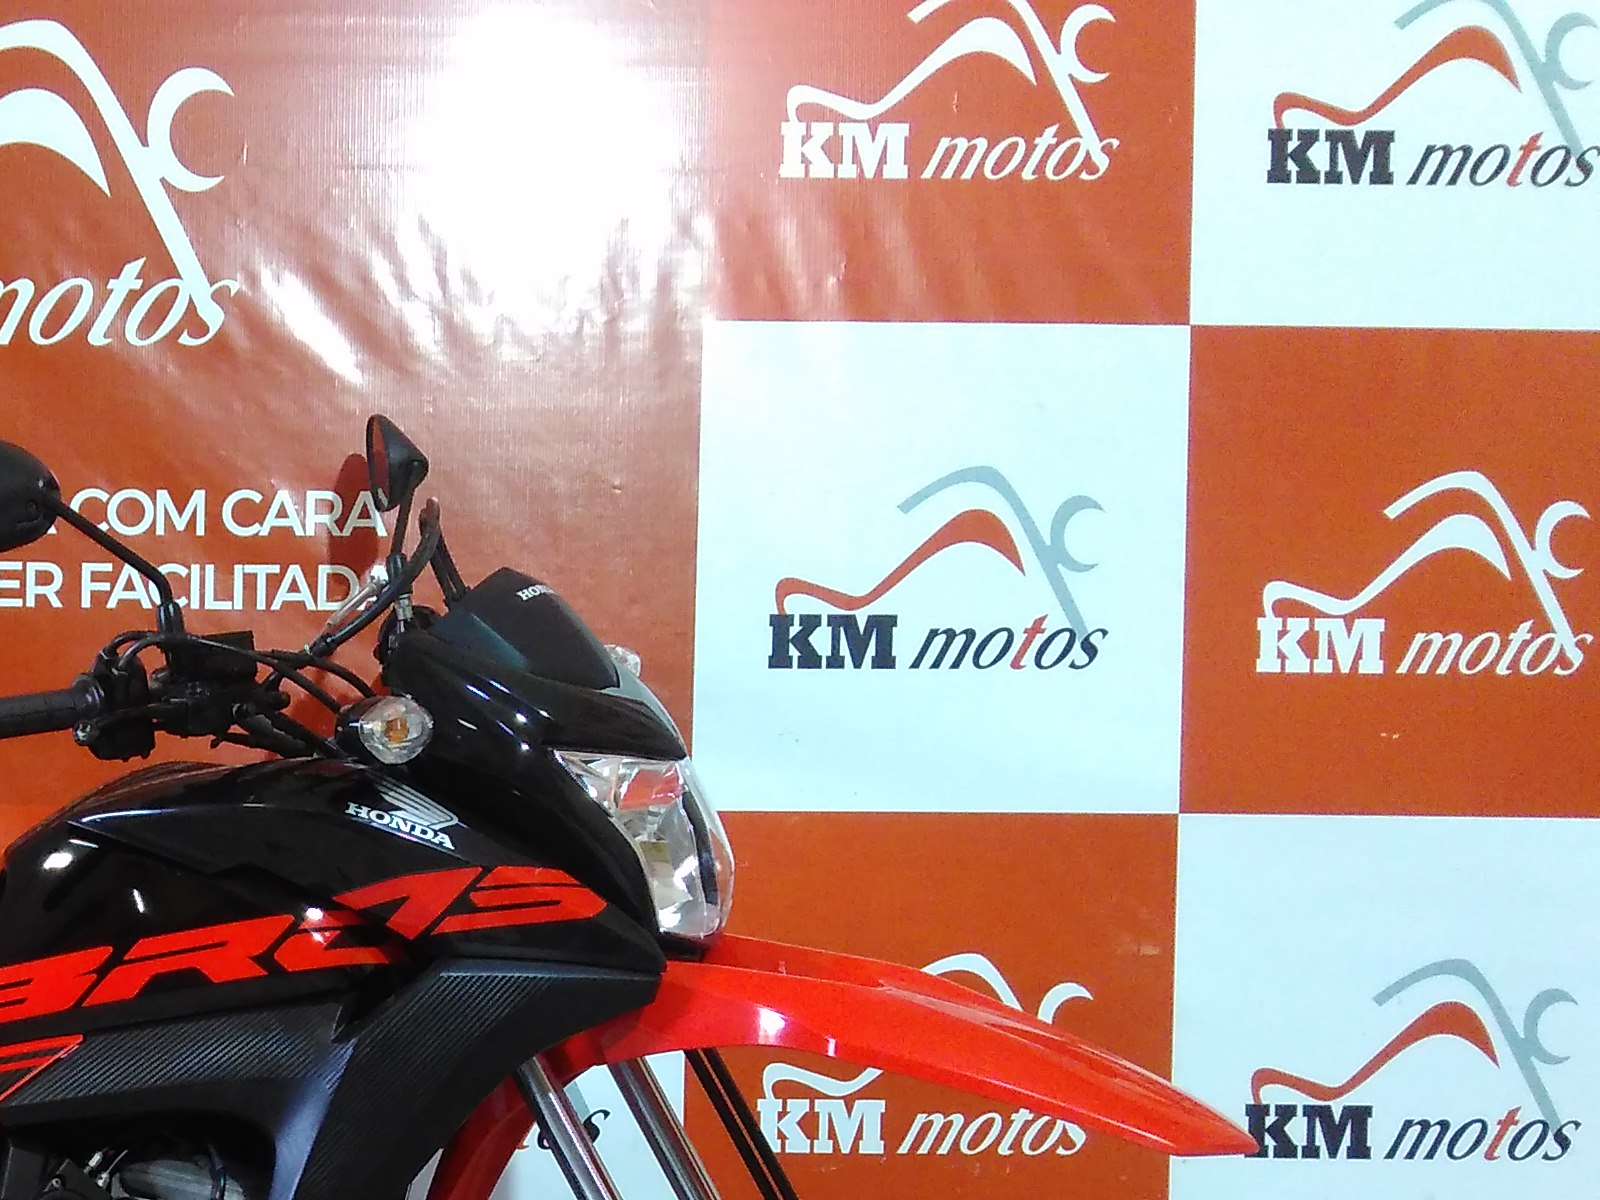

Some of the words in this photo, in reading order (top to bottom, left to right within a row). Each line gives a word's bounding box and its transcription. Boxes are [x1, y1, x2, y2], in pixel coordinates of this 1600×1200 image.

[779, 121, 910, 179] KM
[920, 123, 1120, 181] motos
[1267, 129, 1396, 185] KM
[1405, 131, 1600, 188] motos
[68, 488, 206, 537] COM
[222, 490, 388, 537] CARA
[767, 613, 898, 670] KM
[908, 614, 1109, 670] motos
[1256, 617, 1386, 674] KM
[1396, 619, 1594, 675] motos
[344, 801, 456, 851] HONDA
[757, 1099, 886, 1155] KM
[896, 1107, 1087, 1157] motos
[1243, 1104, 1374, 1160] KM
[1384, 1105, 1583, 1162] motos
